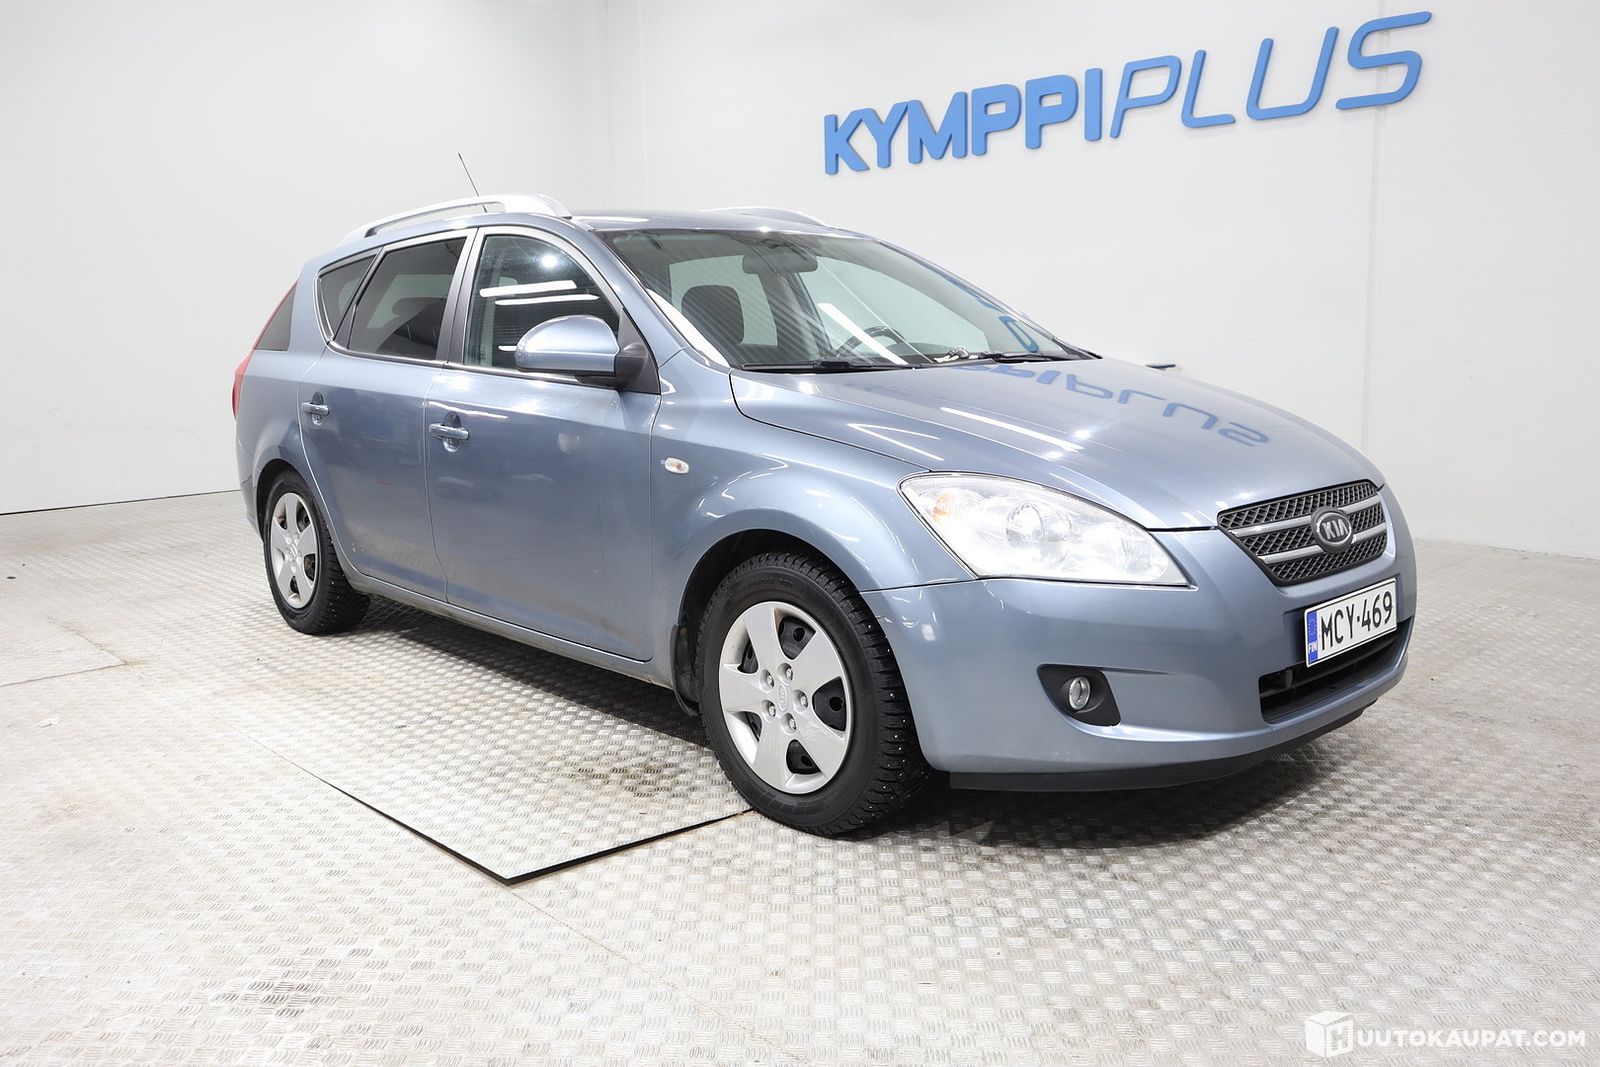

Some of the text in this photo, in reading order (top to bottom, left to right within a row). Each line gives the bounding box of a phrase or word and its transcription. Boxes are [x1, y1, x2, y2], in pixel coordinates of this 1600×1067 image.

[825, 11, 1432, 175] KYMPPIPLUS
[1322, 518, 1348, 540] KIA
[1321, 591, 1392, 650] MCY-469
